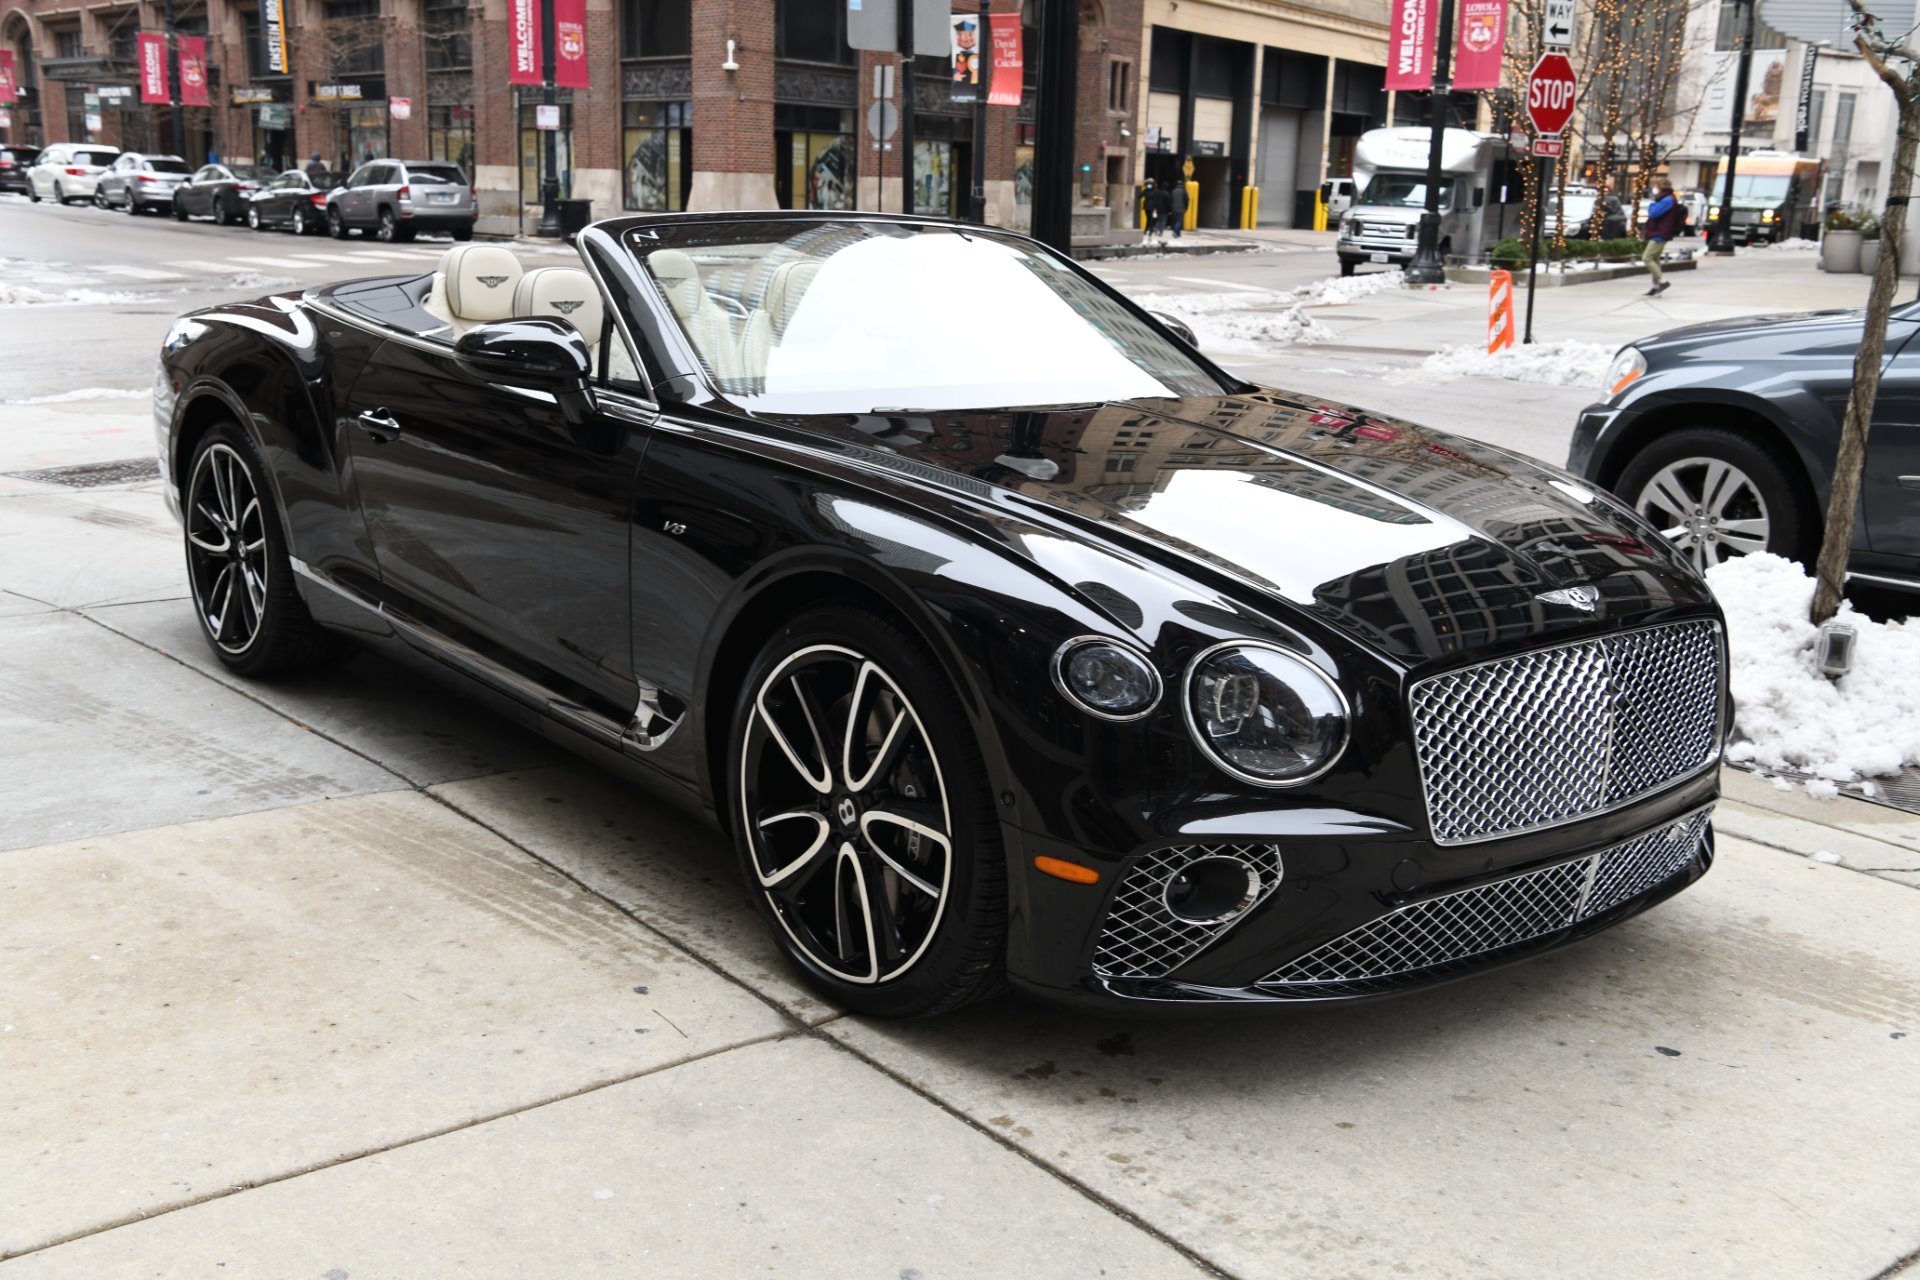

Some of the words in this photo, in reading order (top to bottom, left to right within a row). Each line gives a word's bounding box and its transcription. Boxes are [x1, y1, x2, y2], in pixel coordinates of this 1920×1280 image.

[1465, 2, 1502, 12] LOYOLA
[1549, 4, 1573, 19] WAY
[1415, 16, 1426, 47] TOWER
[267, 23, 283, 72] EINSTEIN
[1413, 46, 1423, 75] WATER
[144, 41, 157, 95] WELCOME
[1530, 78, 1575, 110] STOP
[663, 520, 687, 534] V8
